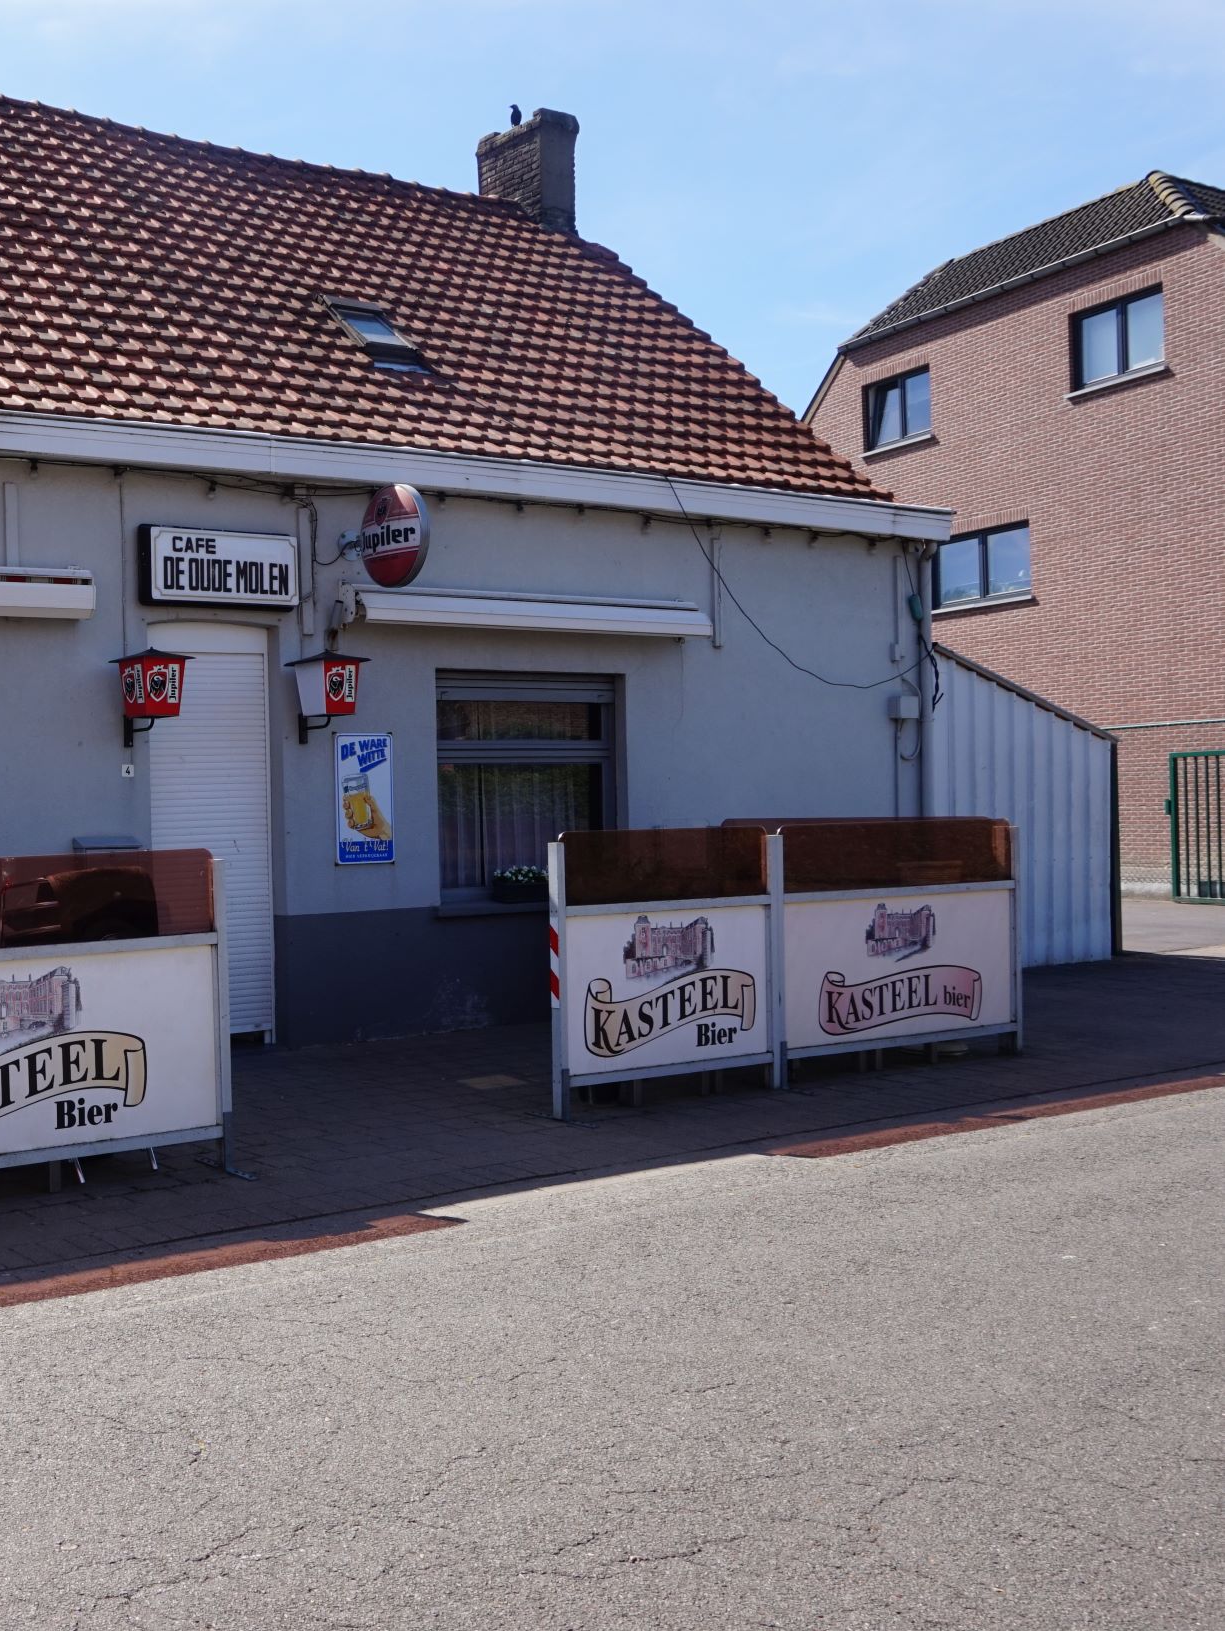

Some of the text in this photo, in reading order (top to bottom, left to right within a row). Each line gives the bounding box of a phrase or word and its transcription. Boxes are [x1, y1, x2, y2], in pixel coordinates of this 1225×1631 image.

[172, 536, 216, 555] CAFE
[362, 525, 416, 553] Jupiler
[163, 555, 289, 596] DE OUDE MOLEN
[136, 666, 144, 701] Jupiler
[169, 666, 177, 701] Jupiler
[346, 667, 354, 701] Jupiler
[341, 738, 388, 762] DE WARE
[356, 748, 386, 767] WITTE
[125, 765, 131, 776] 4
[341, 838, 360, 852] Van
[592, 974, 740, 1055] KASTEEL
[826, 974, 971, 1030] KASTEEL bier
[695, 1021, 737, 1048] Bier
[54, 1097, 119, 1130] Bier
